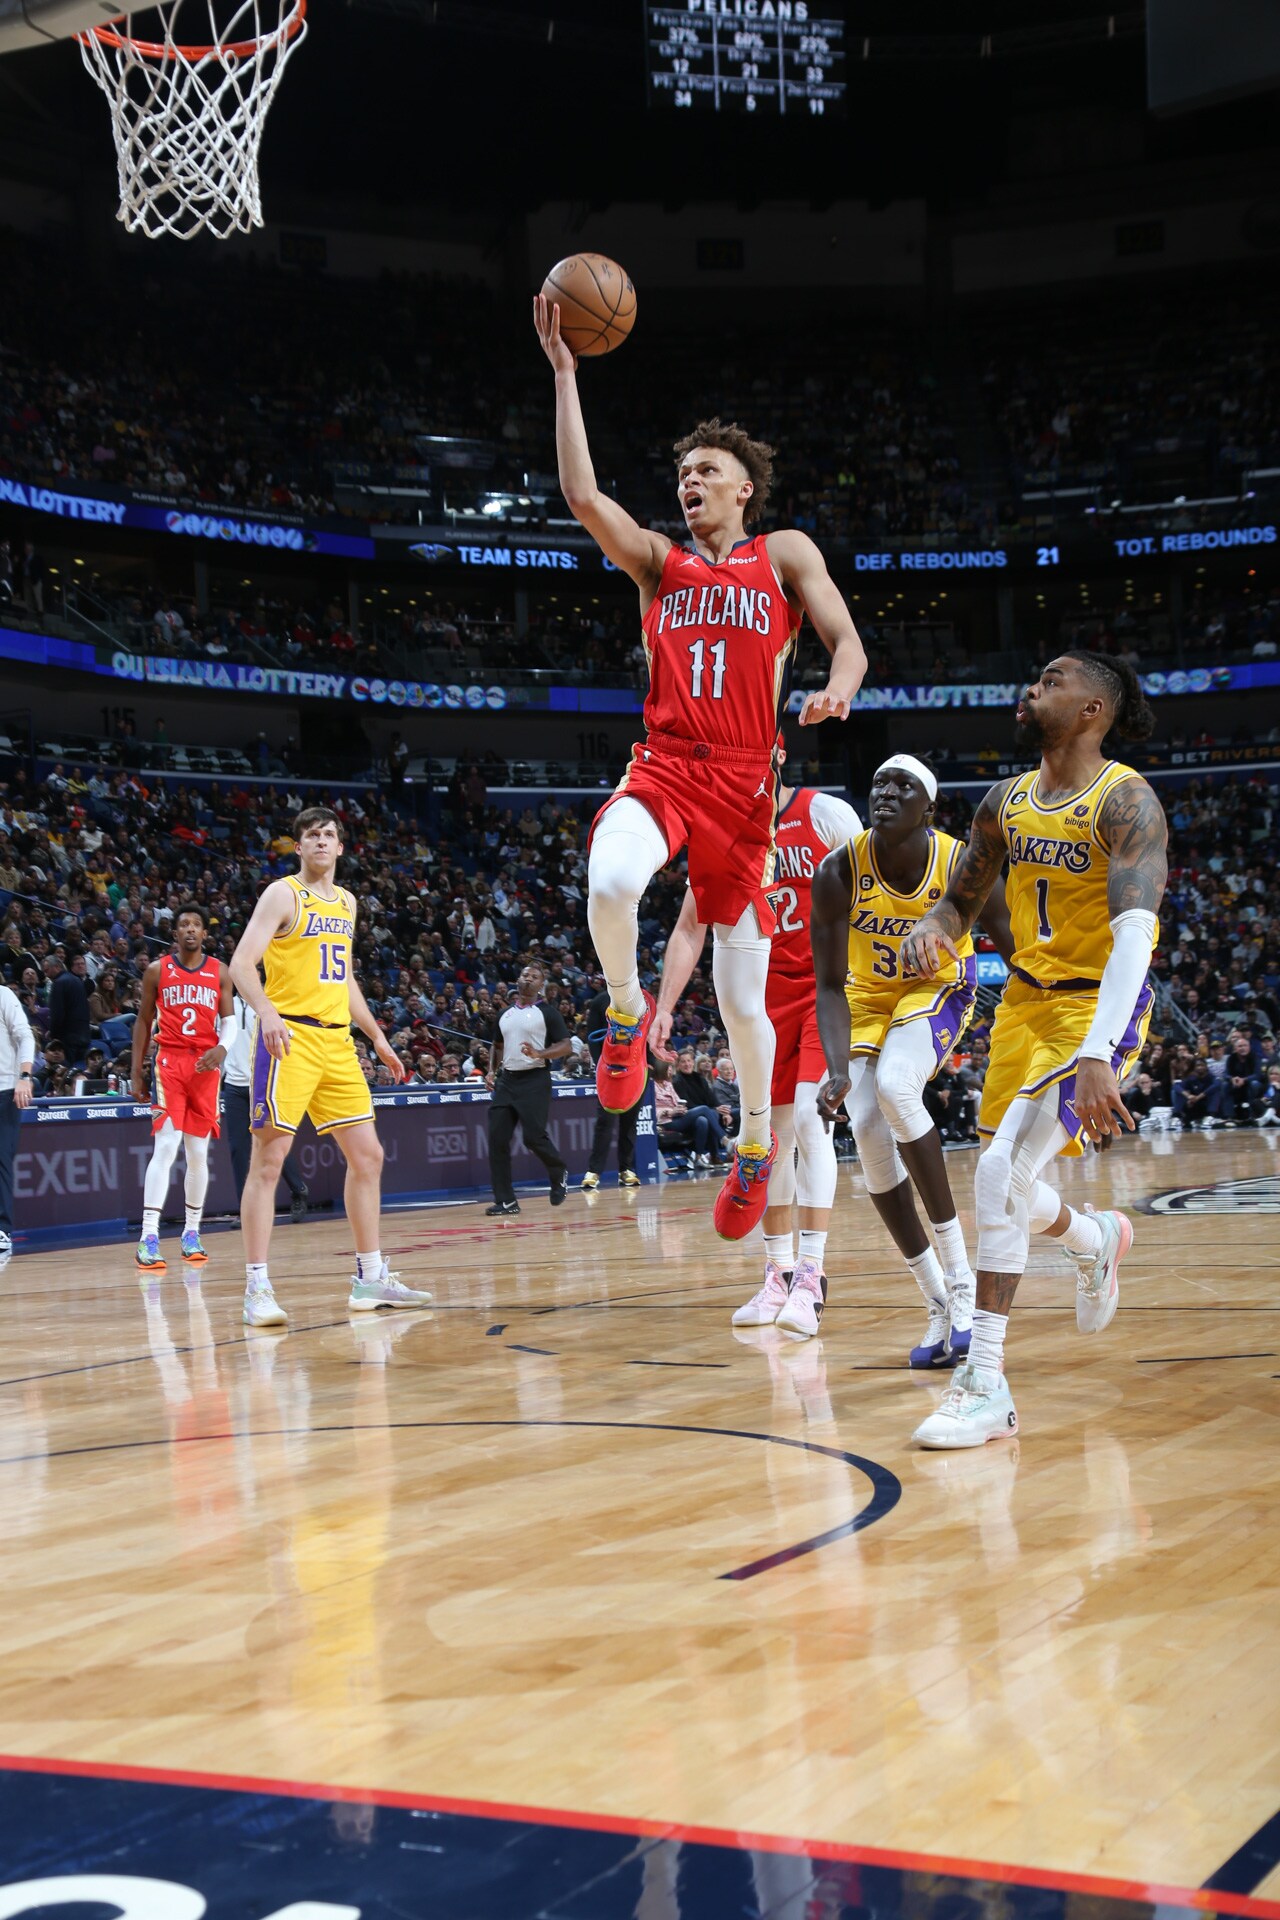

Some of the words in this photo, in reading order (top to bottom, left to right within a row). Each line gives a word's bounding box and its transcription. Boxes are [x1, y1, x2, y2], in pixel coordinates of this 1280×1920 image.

[688, 0, 809, 21] PELICANS
[29, 486, 126, 525] LOTTERY
[1115, 537, 1157, 556] TOT.
[1162, 526, 1277, 552] REBOUNDS
[458, 546, 511, 565] TEAM
[515, 550, 578, 570] STATS:
[728, 555, 757, 566] ibotta
[855, 553, 896, 571] DEF.
[901, 551, 1007, 569] REBOUNDS
[1036, 546, 1059, 566] 21
[657, 584, 771, 636] PELICANS
[238, 667, 346, 698] LOTTERY
[688, 639, 727, 700] 11
[916, 684, 1016, 708] LOTTERY
[1064, 816, 1090, 829] bibigo
[1007, 826, 1093, 875] LAKERS
[861, 876, 871, 889] 6
[774, 885, 804, 934] 2
[850, 908, 920, 938] LAKE
[1035, 878, 1053, 943] 1
[301, 912, 354, 940] LAKERS
[319, 942, 347, 982] 15
[162, 984, 217, 1010] PELICANS
[181, 1007, 197, 1035] 2
[37, 1109, 70, 1121] SEATGEEK
[86, 1107, 118, 1118] SEATGEEK
[132, 1106, 151, 1117] SEATG
[637, 1105, 652, 1120] EAT
[14, 1147, 119, 1199] EXEN
